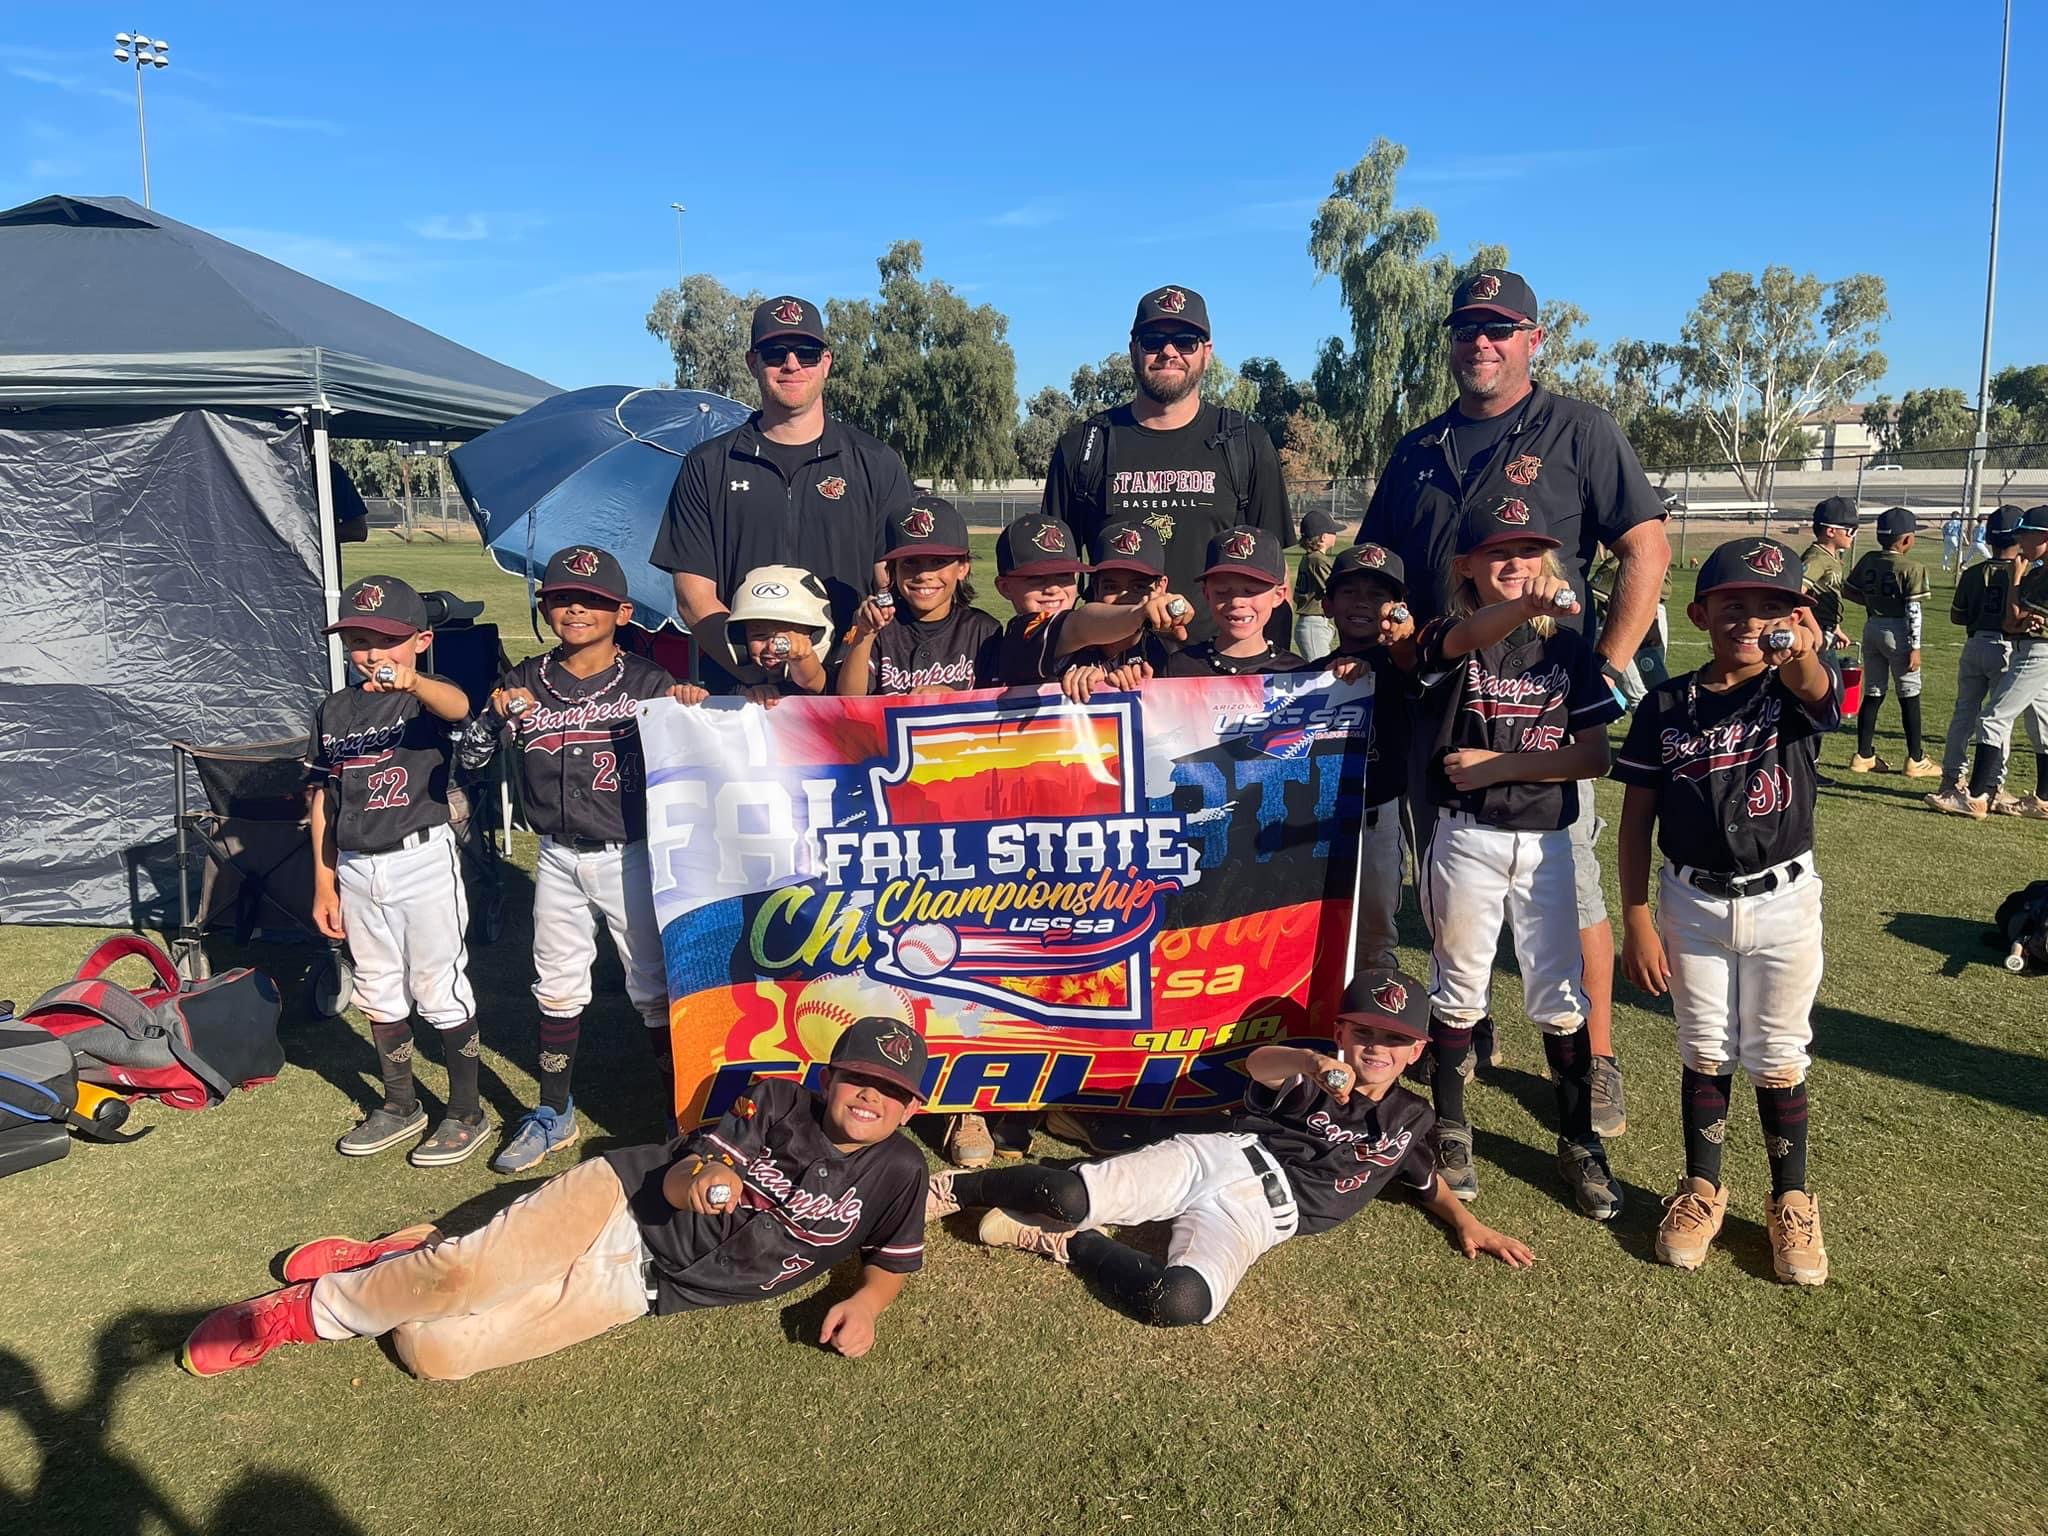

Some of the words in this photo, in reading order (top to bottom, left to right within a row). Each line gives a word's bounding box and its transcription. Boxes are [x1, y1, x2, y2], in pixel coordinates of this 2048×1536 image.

[1122, 499, 1197, 508] BASEBALL
[521, 692, 639, 735] Stampede
[1211, 703, 1259, 712] ARIZONA
[364, 766, 409, 811] 22
[592, 751, 640, 792] 24
[647, 777, 840, 895] FAL
[823, 828, 976, 887] FALL
[987, 817, 1184, 875] STATE
[875, 866, 1172, 926] Championship
[1133, 1027, 1208, 1053] 9U
[1214, 1015, 1282, 1048] AA
